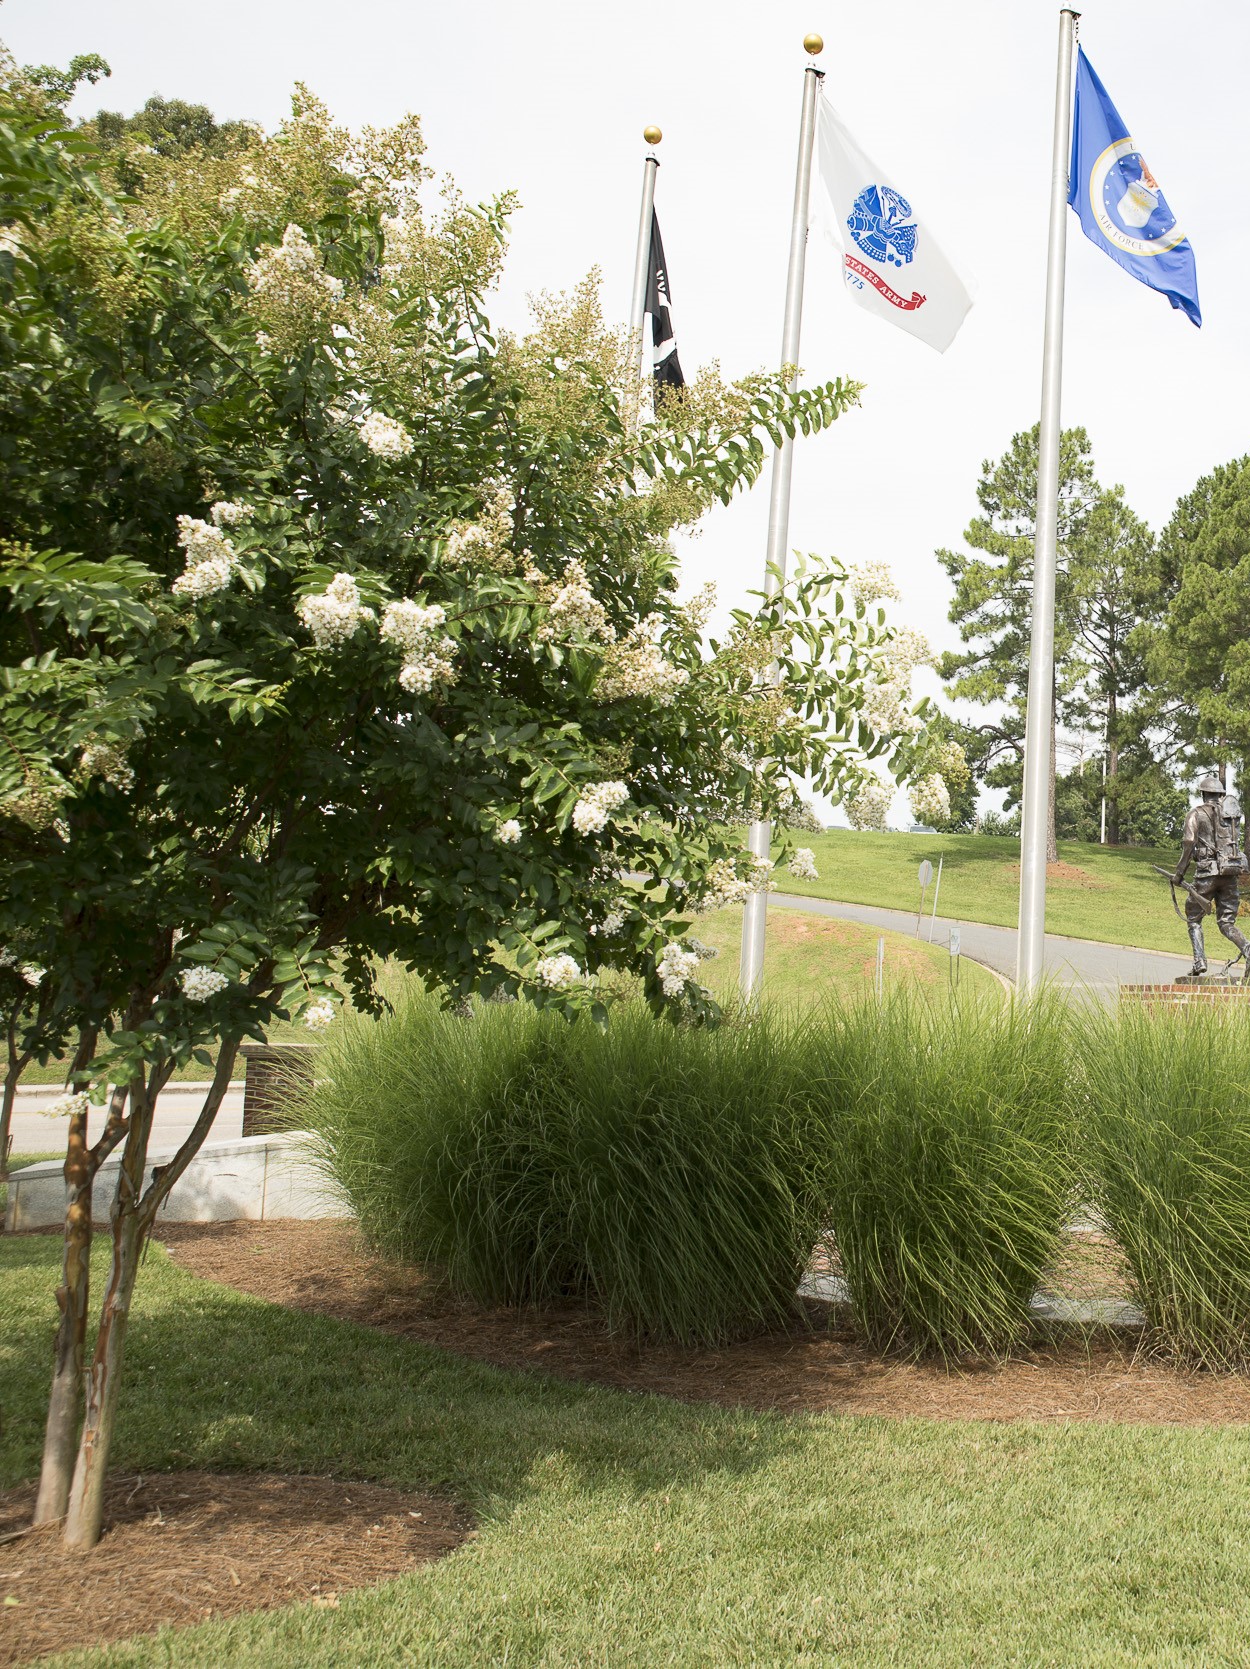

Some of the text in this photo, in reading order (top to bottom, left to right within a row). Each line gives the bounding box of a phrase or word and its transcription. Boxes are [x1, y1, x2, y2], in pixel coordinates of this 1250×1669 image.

[1099, 214, 1143, 250] AIR FORCE
[845, 271, 865, 289] 775
[845, 257, 907, 307] STATES ARMY
